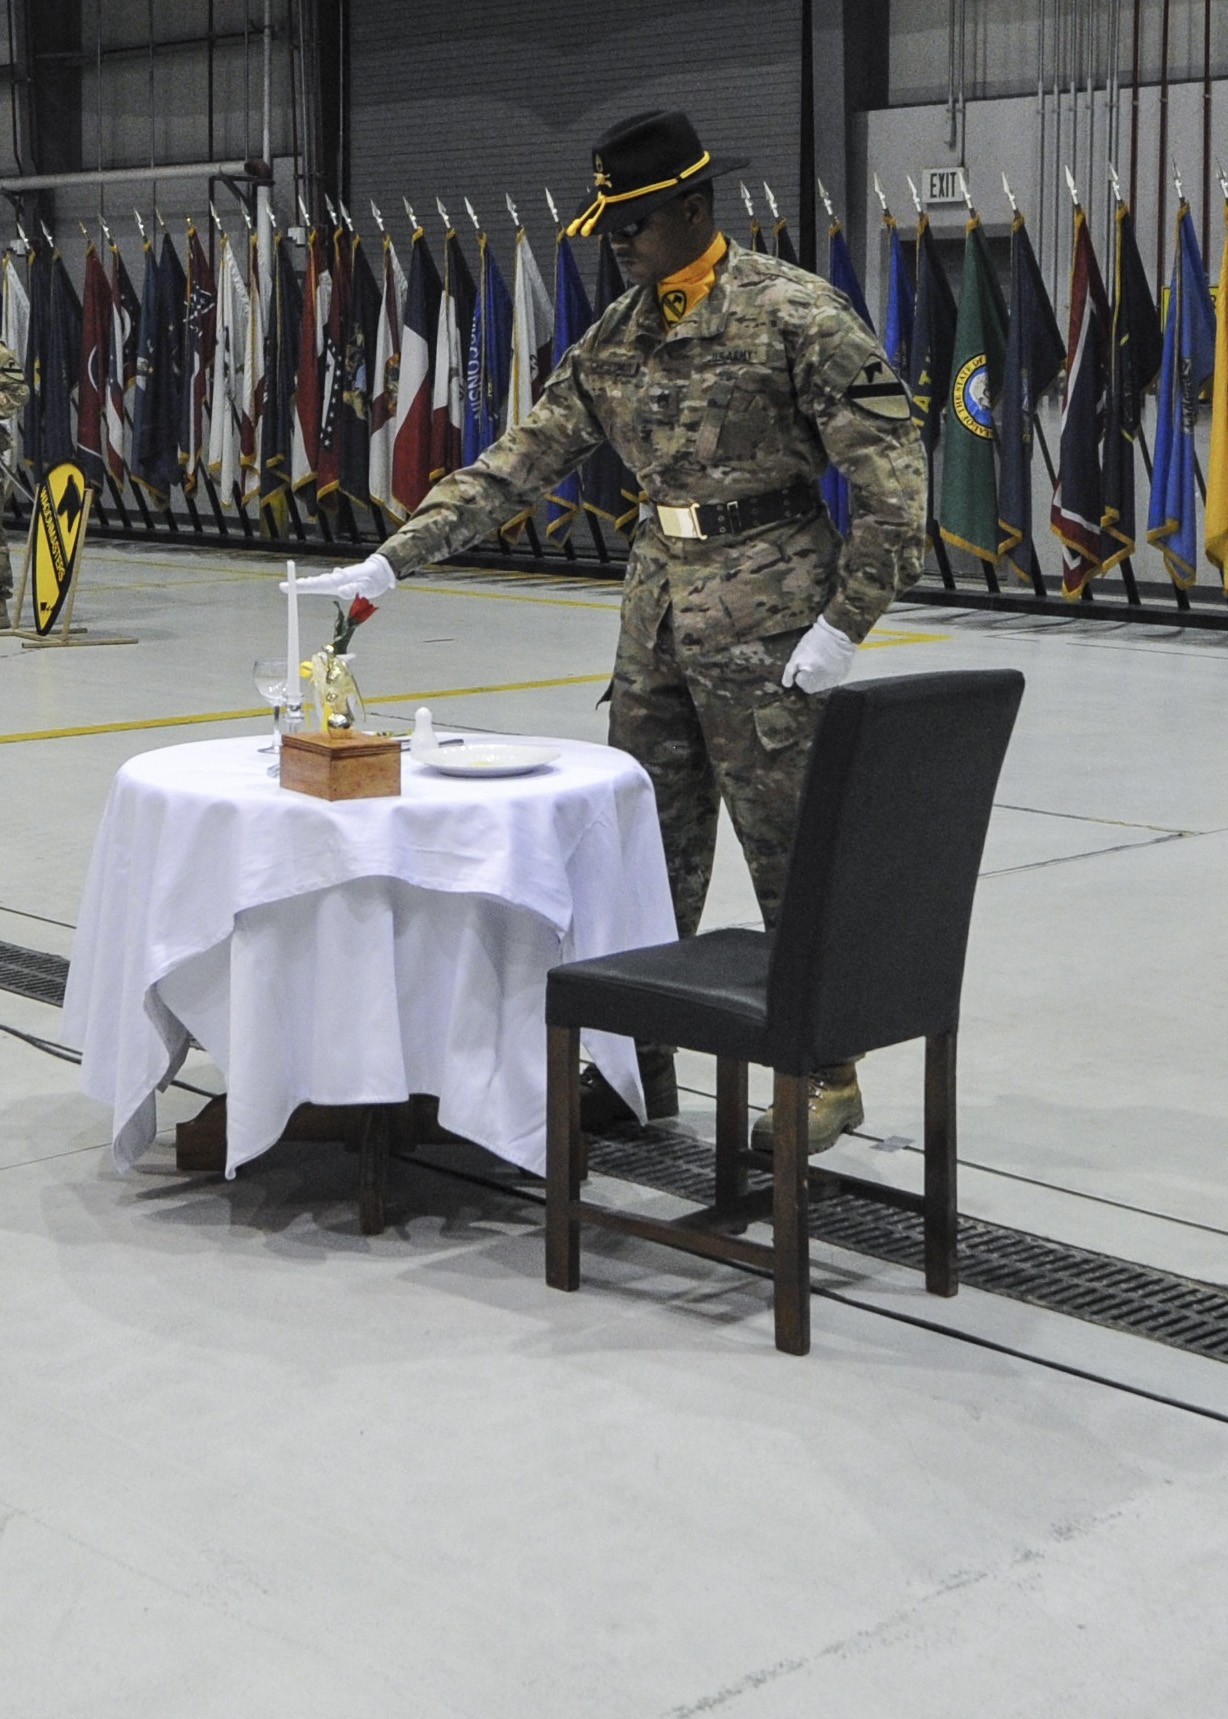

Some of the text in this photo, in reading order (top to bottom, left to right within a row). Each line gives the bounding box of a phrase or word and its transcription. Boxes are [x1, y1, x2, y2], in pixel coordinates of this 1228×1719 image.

[930, 171, 957, 198] EXIT
[956, 367, 971, 392] STATE
[955, 397, 965, 414] THE
